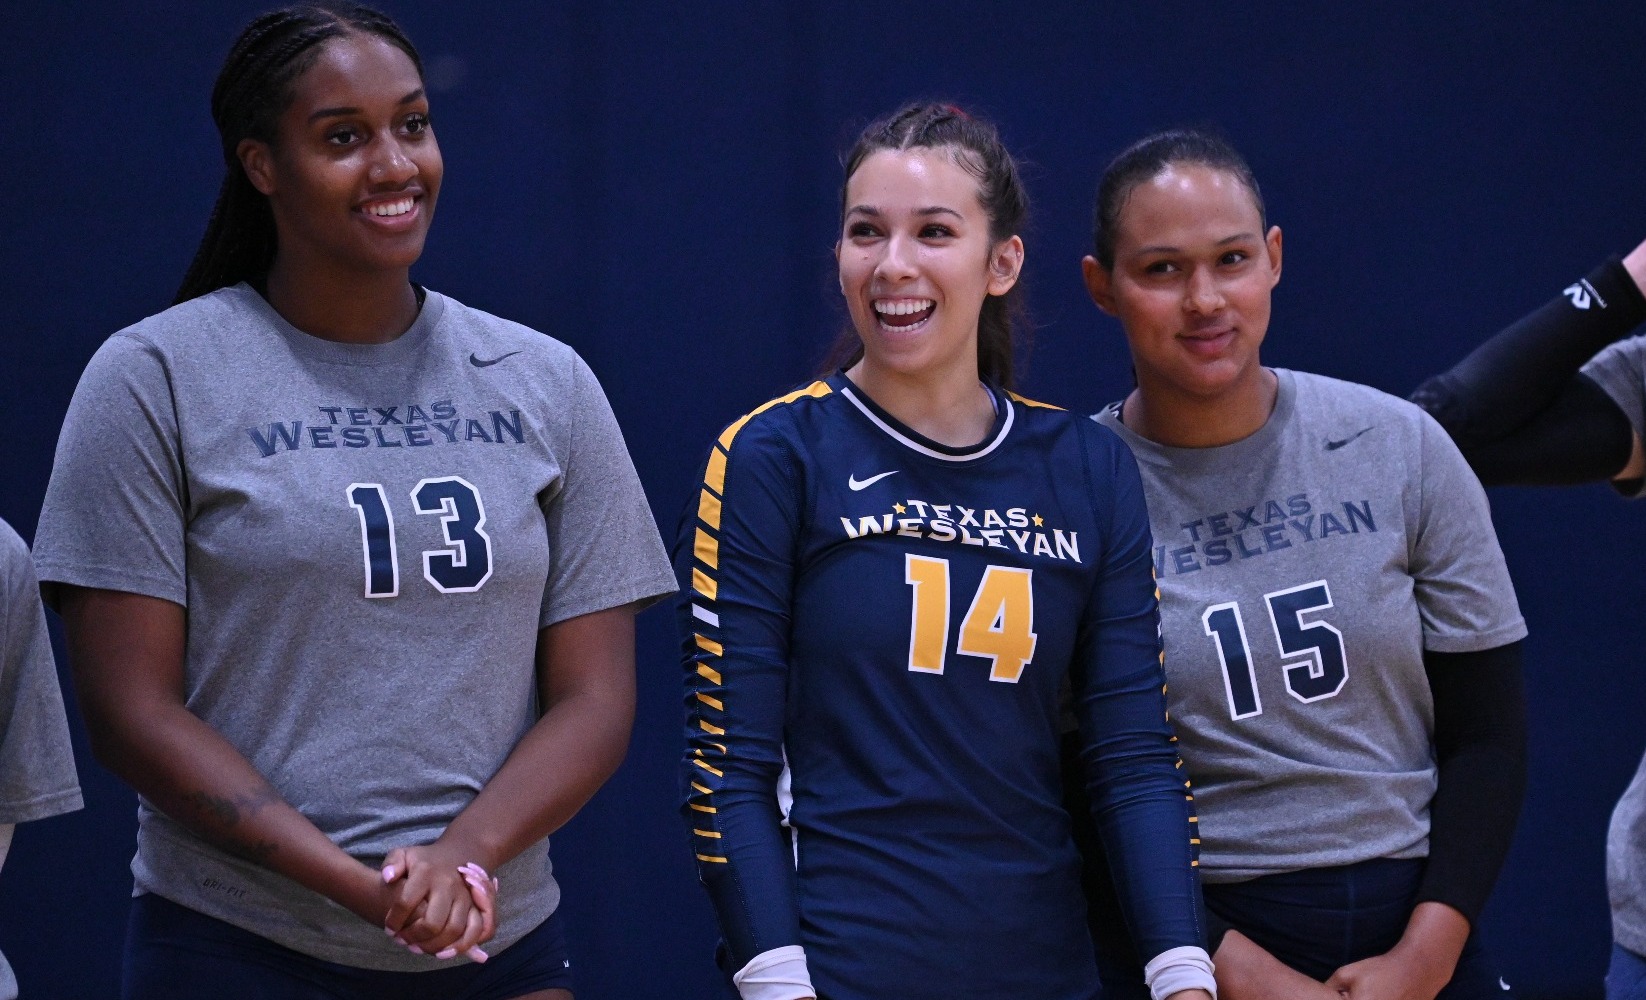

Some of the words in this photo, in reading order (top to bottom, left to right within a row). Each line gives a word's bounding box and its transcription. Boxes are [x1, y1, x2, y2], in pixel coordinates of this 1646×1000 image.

[247, 410, 526, 458] WESLEYAN
[318, 400, 457, 425] TEXAS
[346, 475, 493, 598] 13
[907, 499, 1028, 528] TEXAS
[1180, 493, 1312, 543] TEXAS
[840, 514, 1082, 563] WESLEYAN
[1153, 499, 1379, 579] ESLEYAN
[905, 552, 1038, 684] 14
[1201, 579, 1350, 721] 15
[203, 878, 247, 898] DRI-FIT
